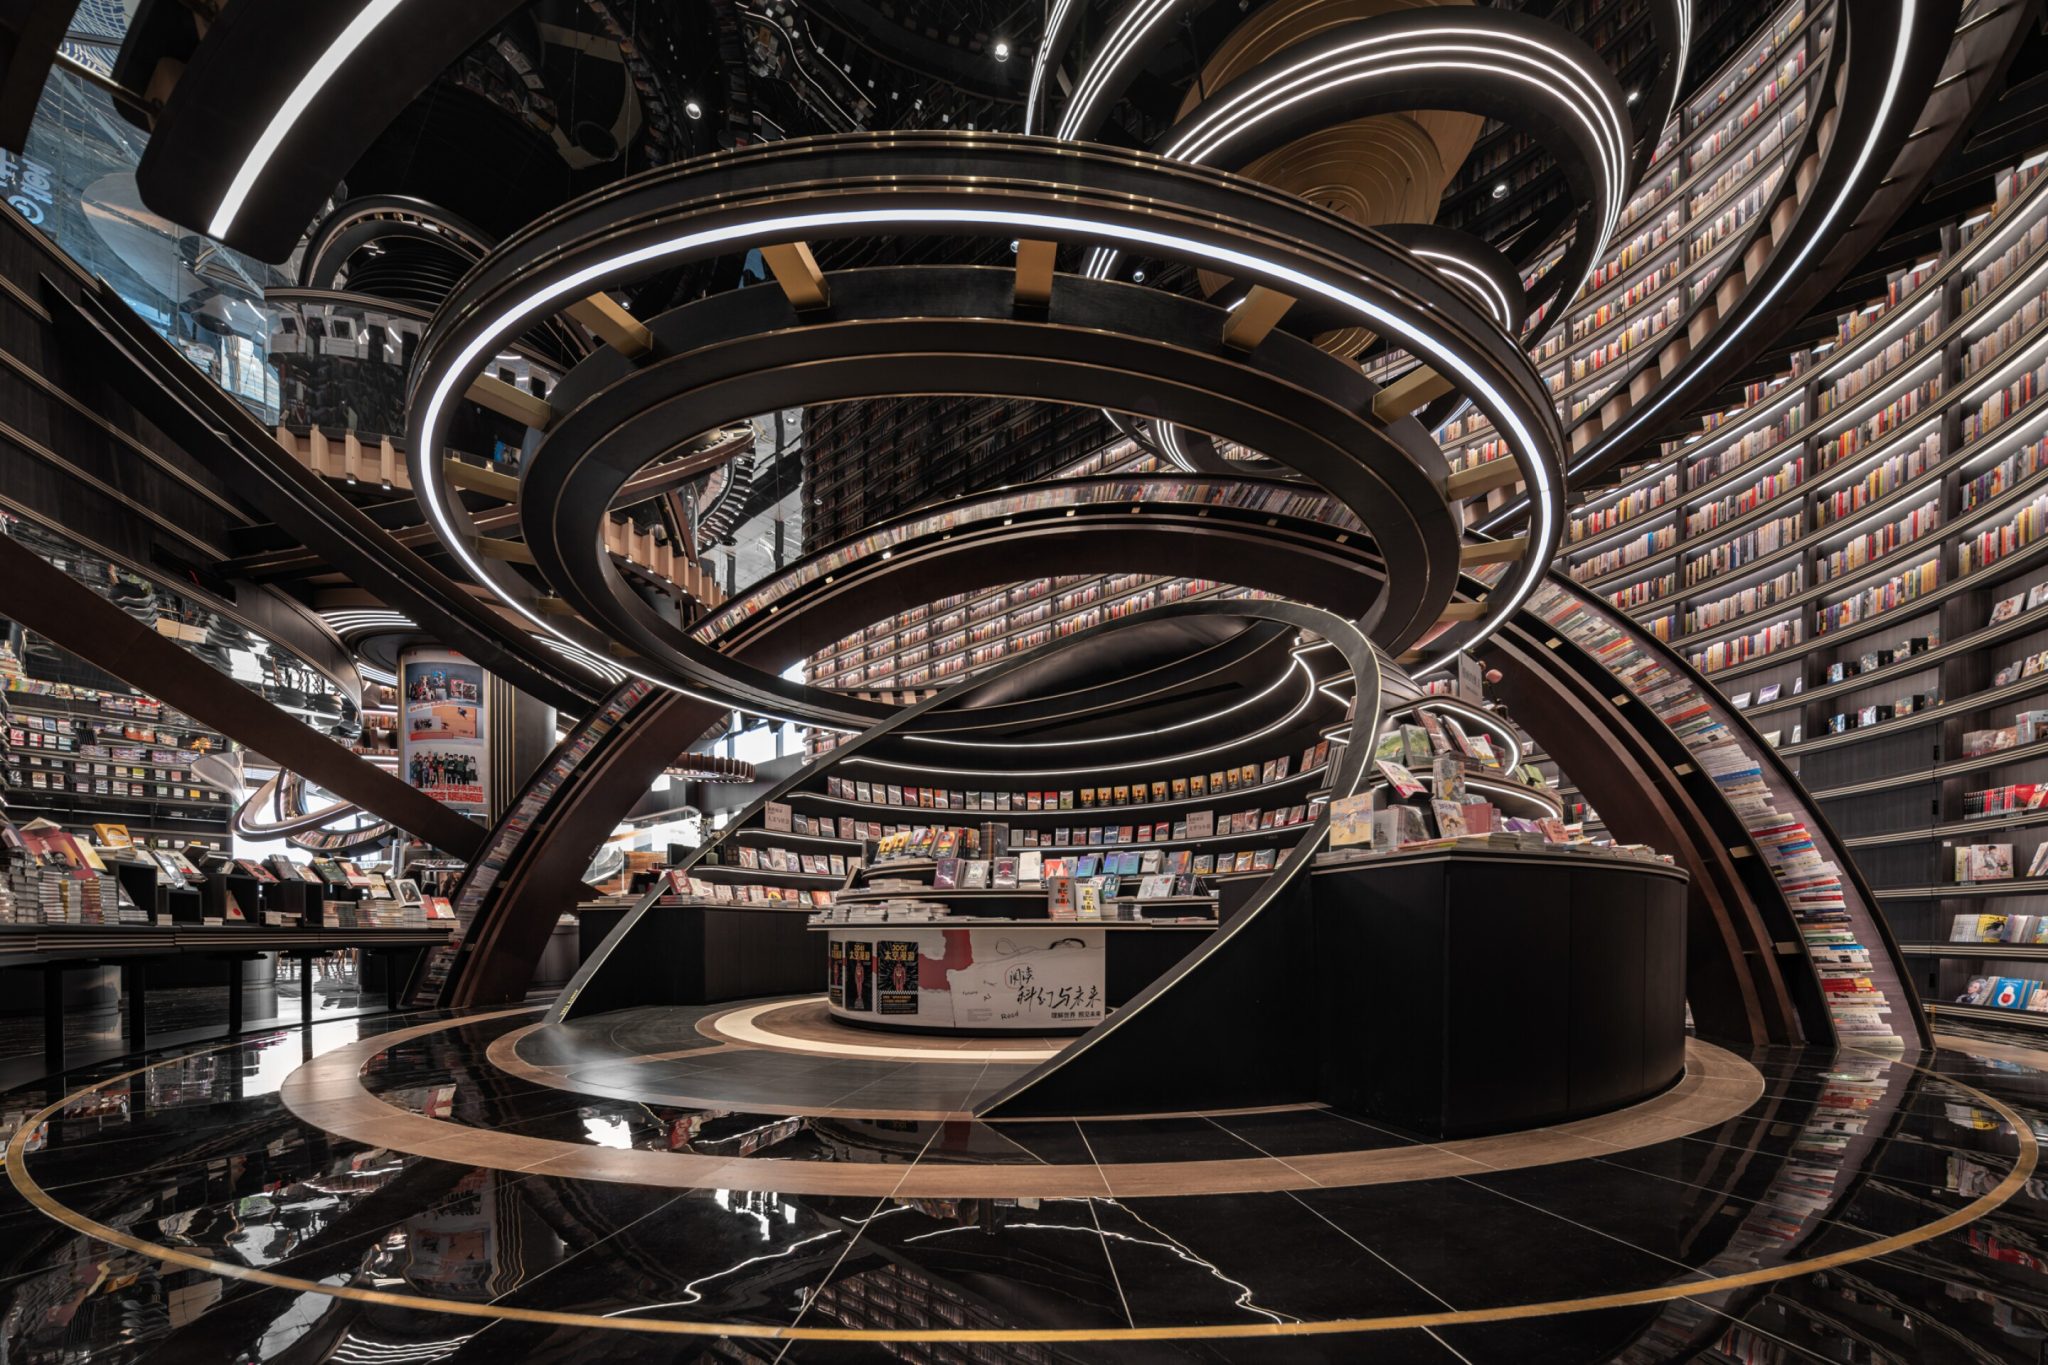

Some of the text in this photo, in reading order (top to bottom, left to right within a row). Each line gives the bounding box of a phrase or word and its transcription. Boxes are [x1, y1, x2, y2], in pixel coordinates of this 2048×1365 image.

[1017, 985, 1101, 1012] 科幻与未来
